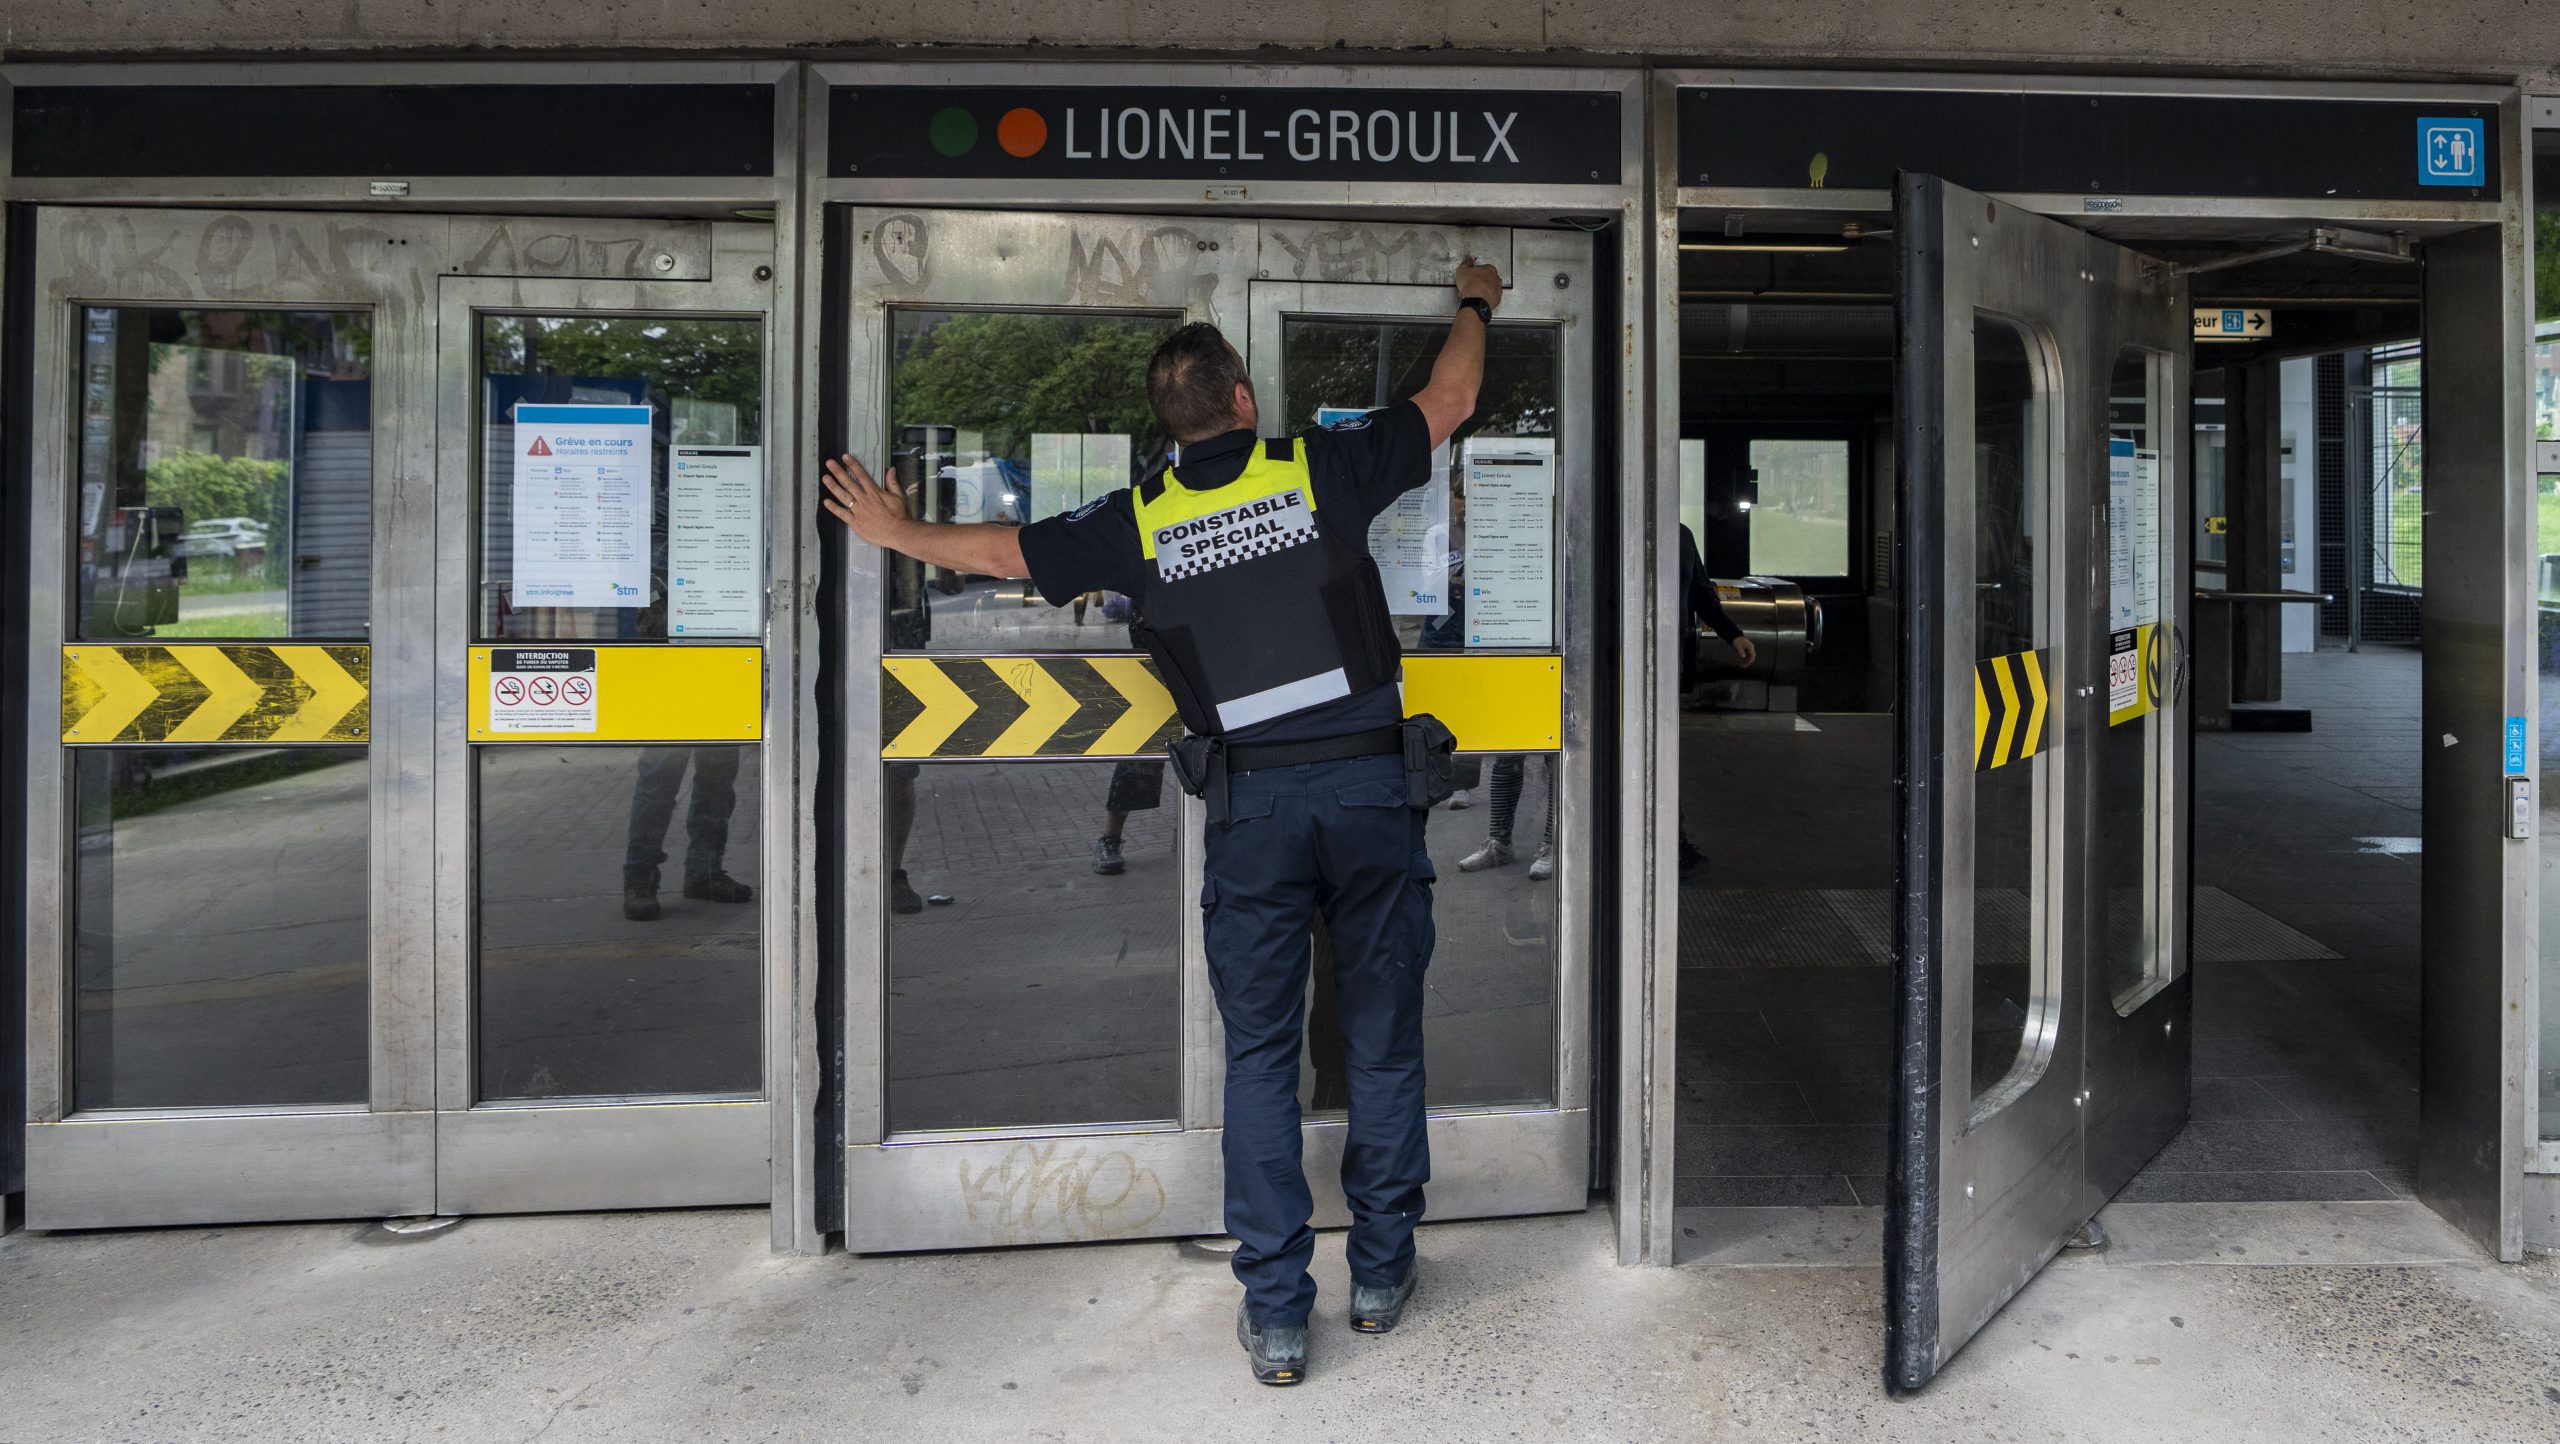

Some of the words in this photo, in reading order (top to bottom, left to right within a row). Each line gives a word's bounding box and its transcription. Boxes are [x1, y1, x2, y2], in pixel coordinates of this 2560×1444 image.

[1065, 107, 1520, 163] LIONEL-GROULX
[555, 437, 586, 446] Grève
[604, 439, 633, 447] cours
[590, 448, 629, 456] restreints
[1157, 492, 1301, 545] CONSTABLE
[1180, 518, 1285, 559] SPÉCIAL
[617, 585, 639, 596] stm
[1416, 594, 1437, 604] stm
